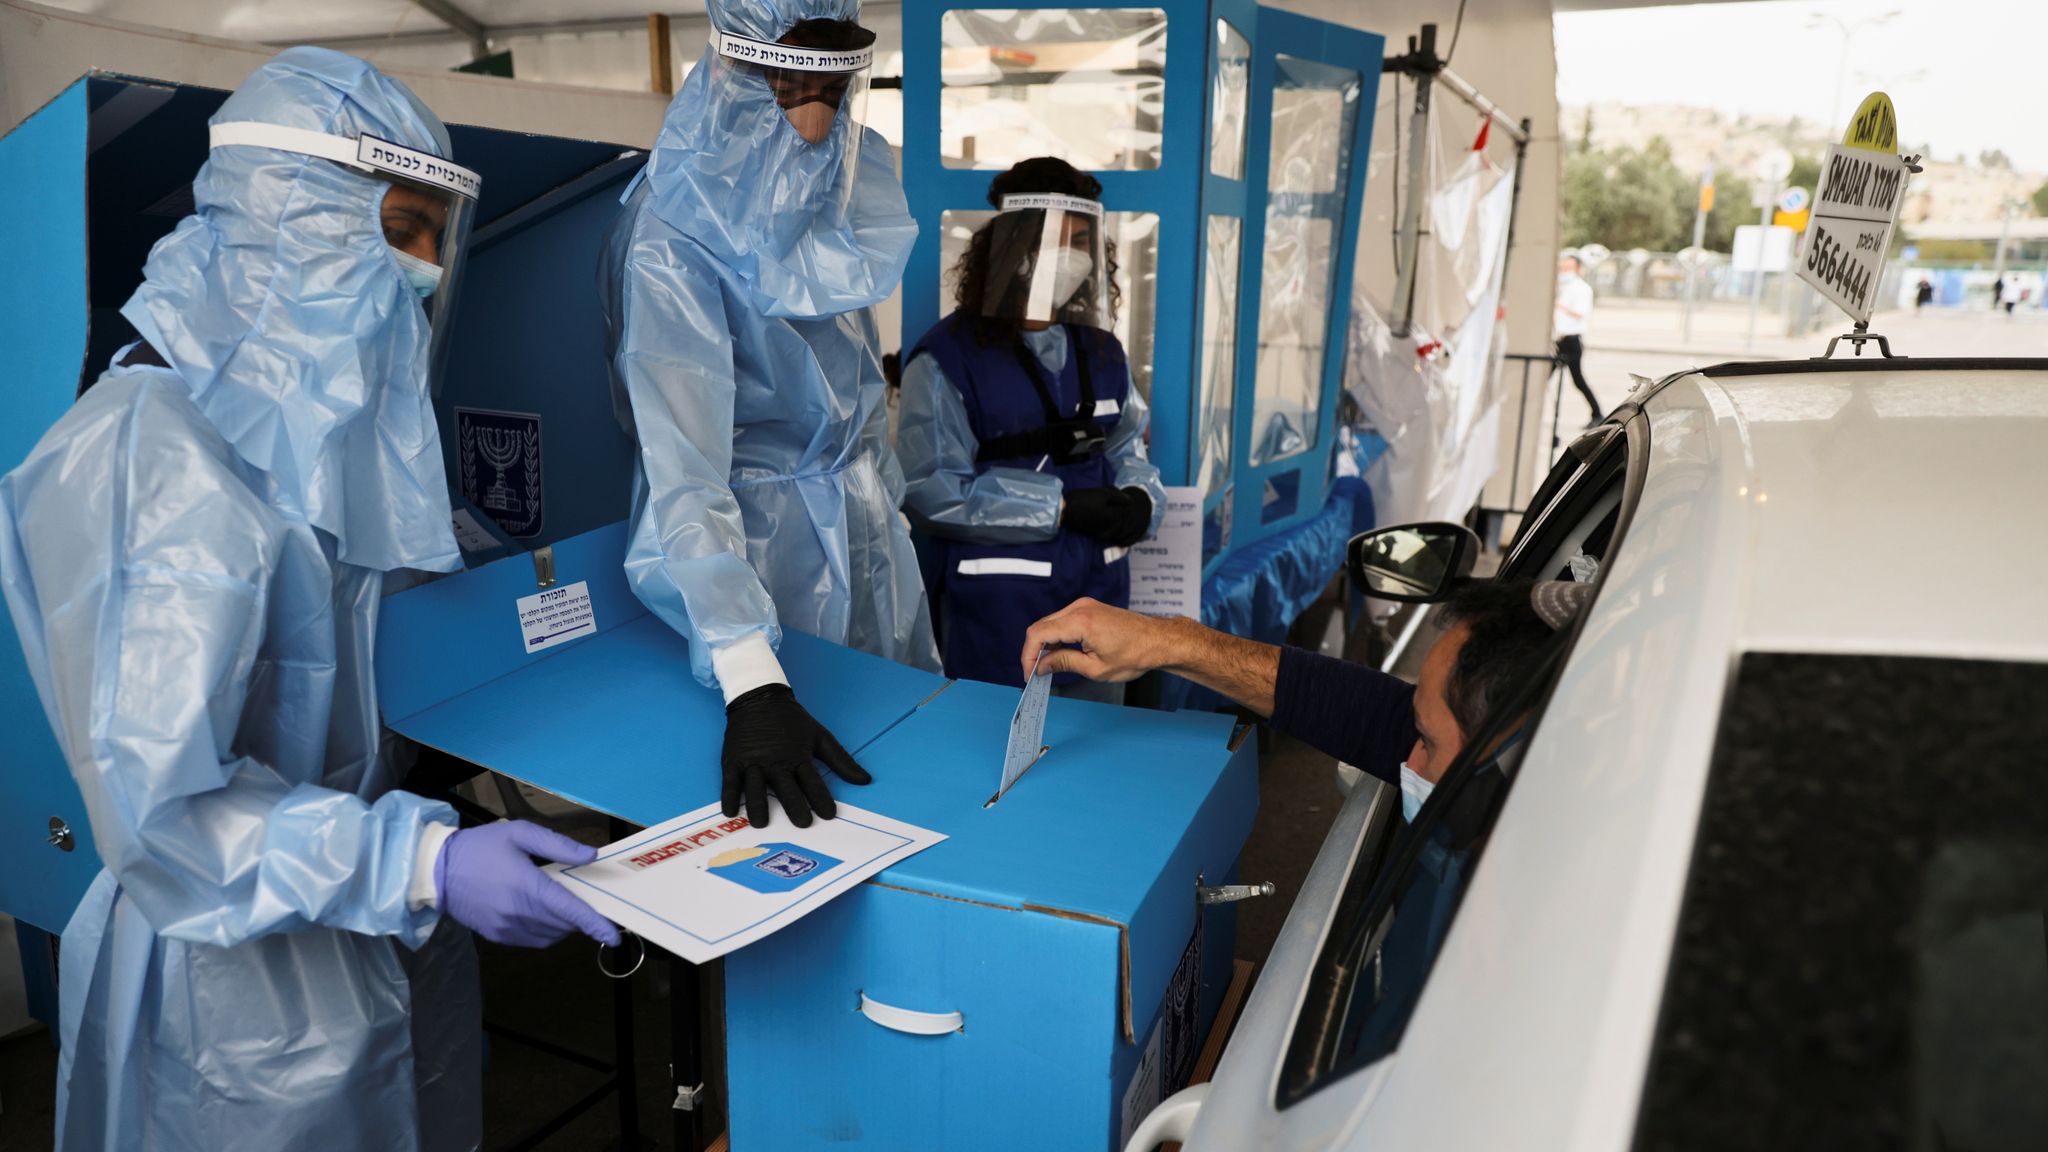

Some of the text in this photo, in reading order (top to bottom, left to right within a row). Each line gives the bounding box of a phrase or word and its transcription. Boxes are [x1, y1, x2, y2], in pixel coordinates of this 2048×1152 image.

[727, 42, 757, 57] לכנסת
[760, 49, 814, 66] המרכזית
[818, 54, 861, 66] הבחירות
[372, 147, 421, 170] לכנסת
[425, 163, 475, 191] המרכזית
[1822, 154, 1872, 207] SMADAR
[1869, 164, 1901, 211] סמדר
[1807, 226, 1871, 310] 5664444
[540, 589, 567, 603] תזכורת
[686, 829, 724, 847] חריץ
[630, 841, 693, 868] ההצבעה
